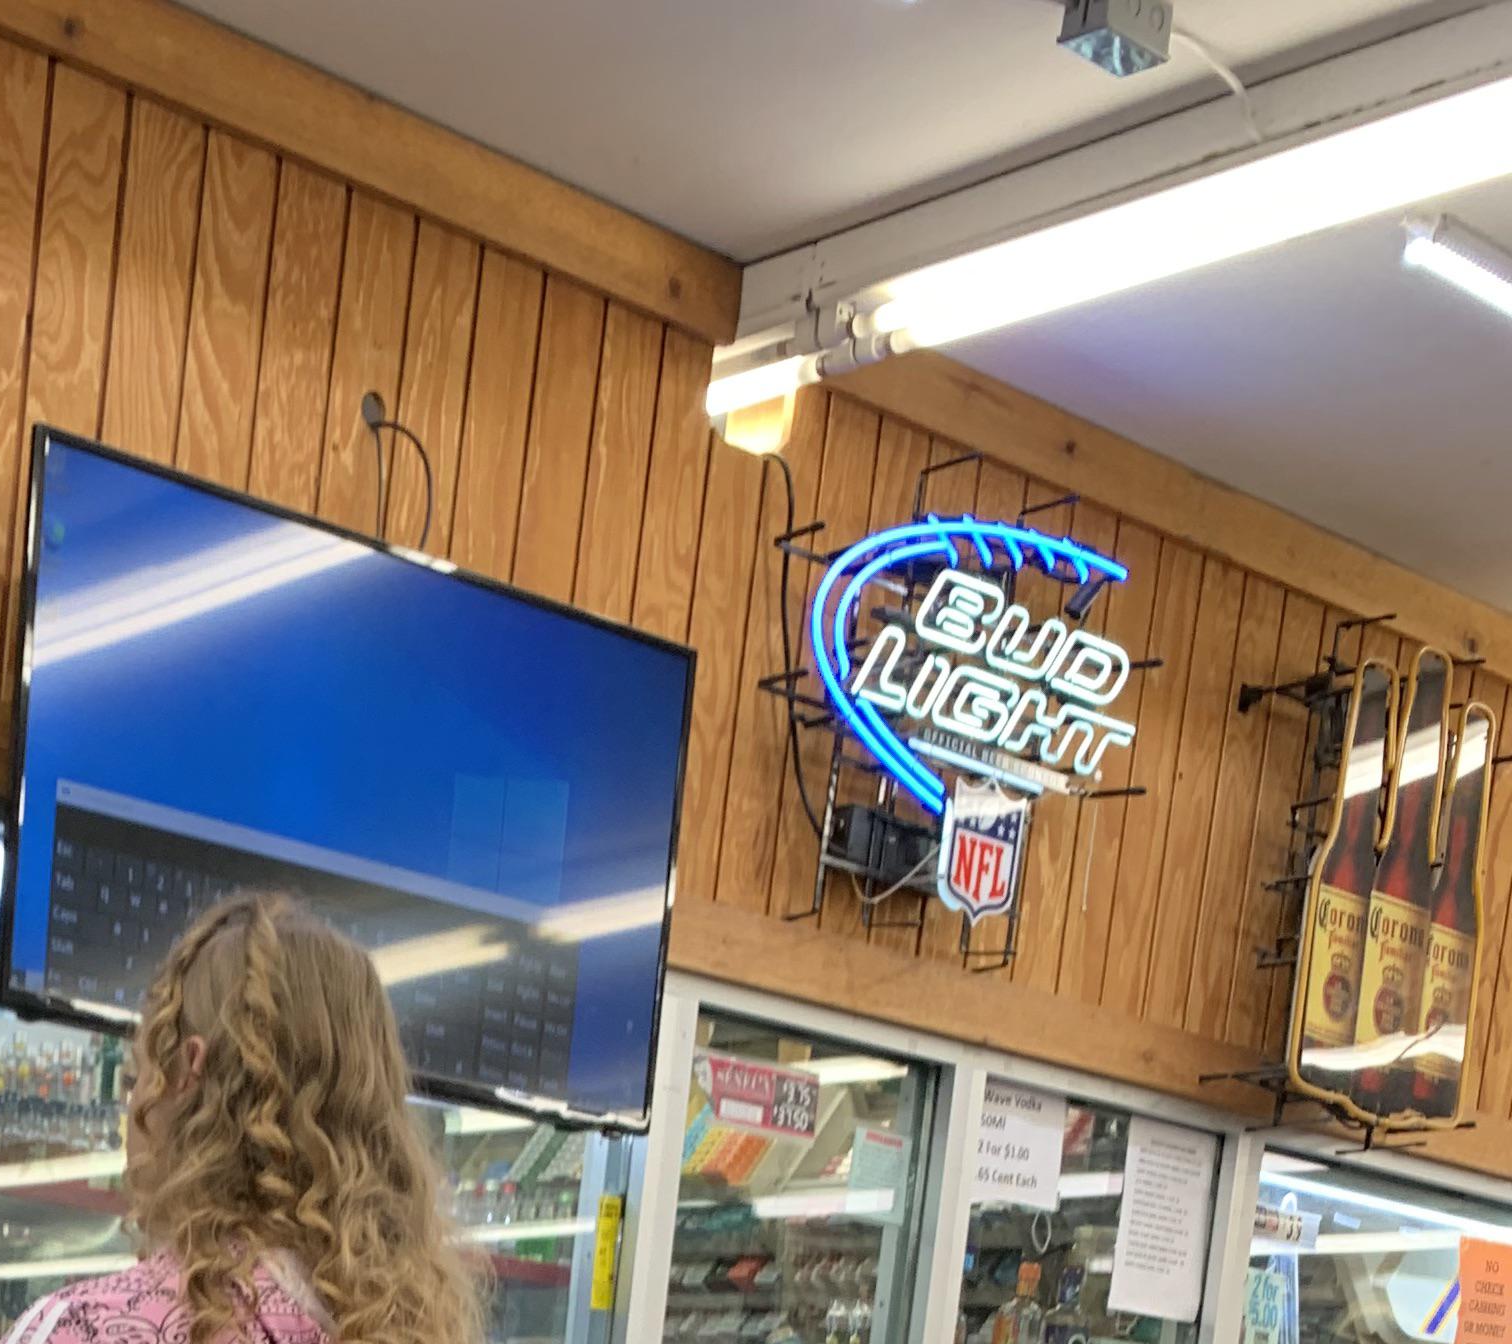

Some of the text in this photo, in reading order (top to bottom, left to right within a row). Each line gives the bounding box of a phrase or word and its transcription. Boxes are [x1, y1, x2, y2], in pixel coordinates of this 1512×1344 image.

[915, 568, 1131, 706] BUD
[850, 625, 1137, 776] LIGHT
[952, 834, 1007, 902] NFL
[1319, 898, 1365, 938] Coron
[1368, 899, 1425, 951] Corona
[984, 1088, 1042, 1113] Wave Vodka
[977, 1139, 1030, 1161] 2 For $1.00
[992, 1170, 1013, 1185] Cent
[1016, 1174, 1038, 1189] Each
[1485, 1259, 1500, 1274] NO
[1251, 1275, 1262, 1298] 2
[1476, 1323, 1506, 1339] MONEY
